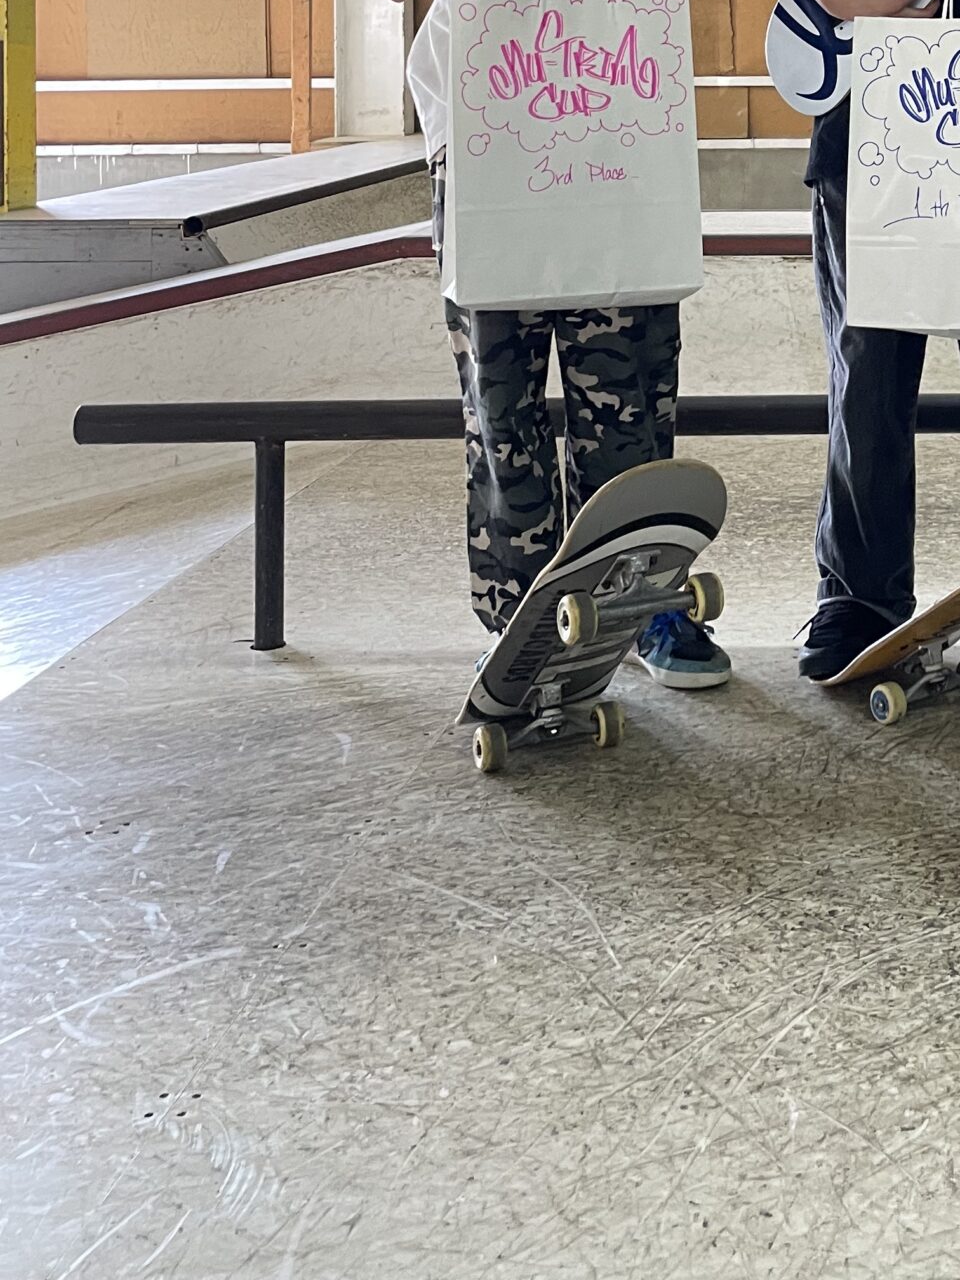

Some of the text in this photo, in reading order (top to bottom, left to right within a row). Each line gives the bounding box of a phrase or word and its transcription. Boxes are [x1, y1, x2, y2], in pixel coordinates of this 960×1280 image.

[528, 83, 612, 122] CUP
[528, 156, 628, 192] 3rd Place
